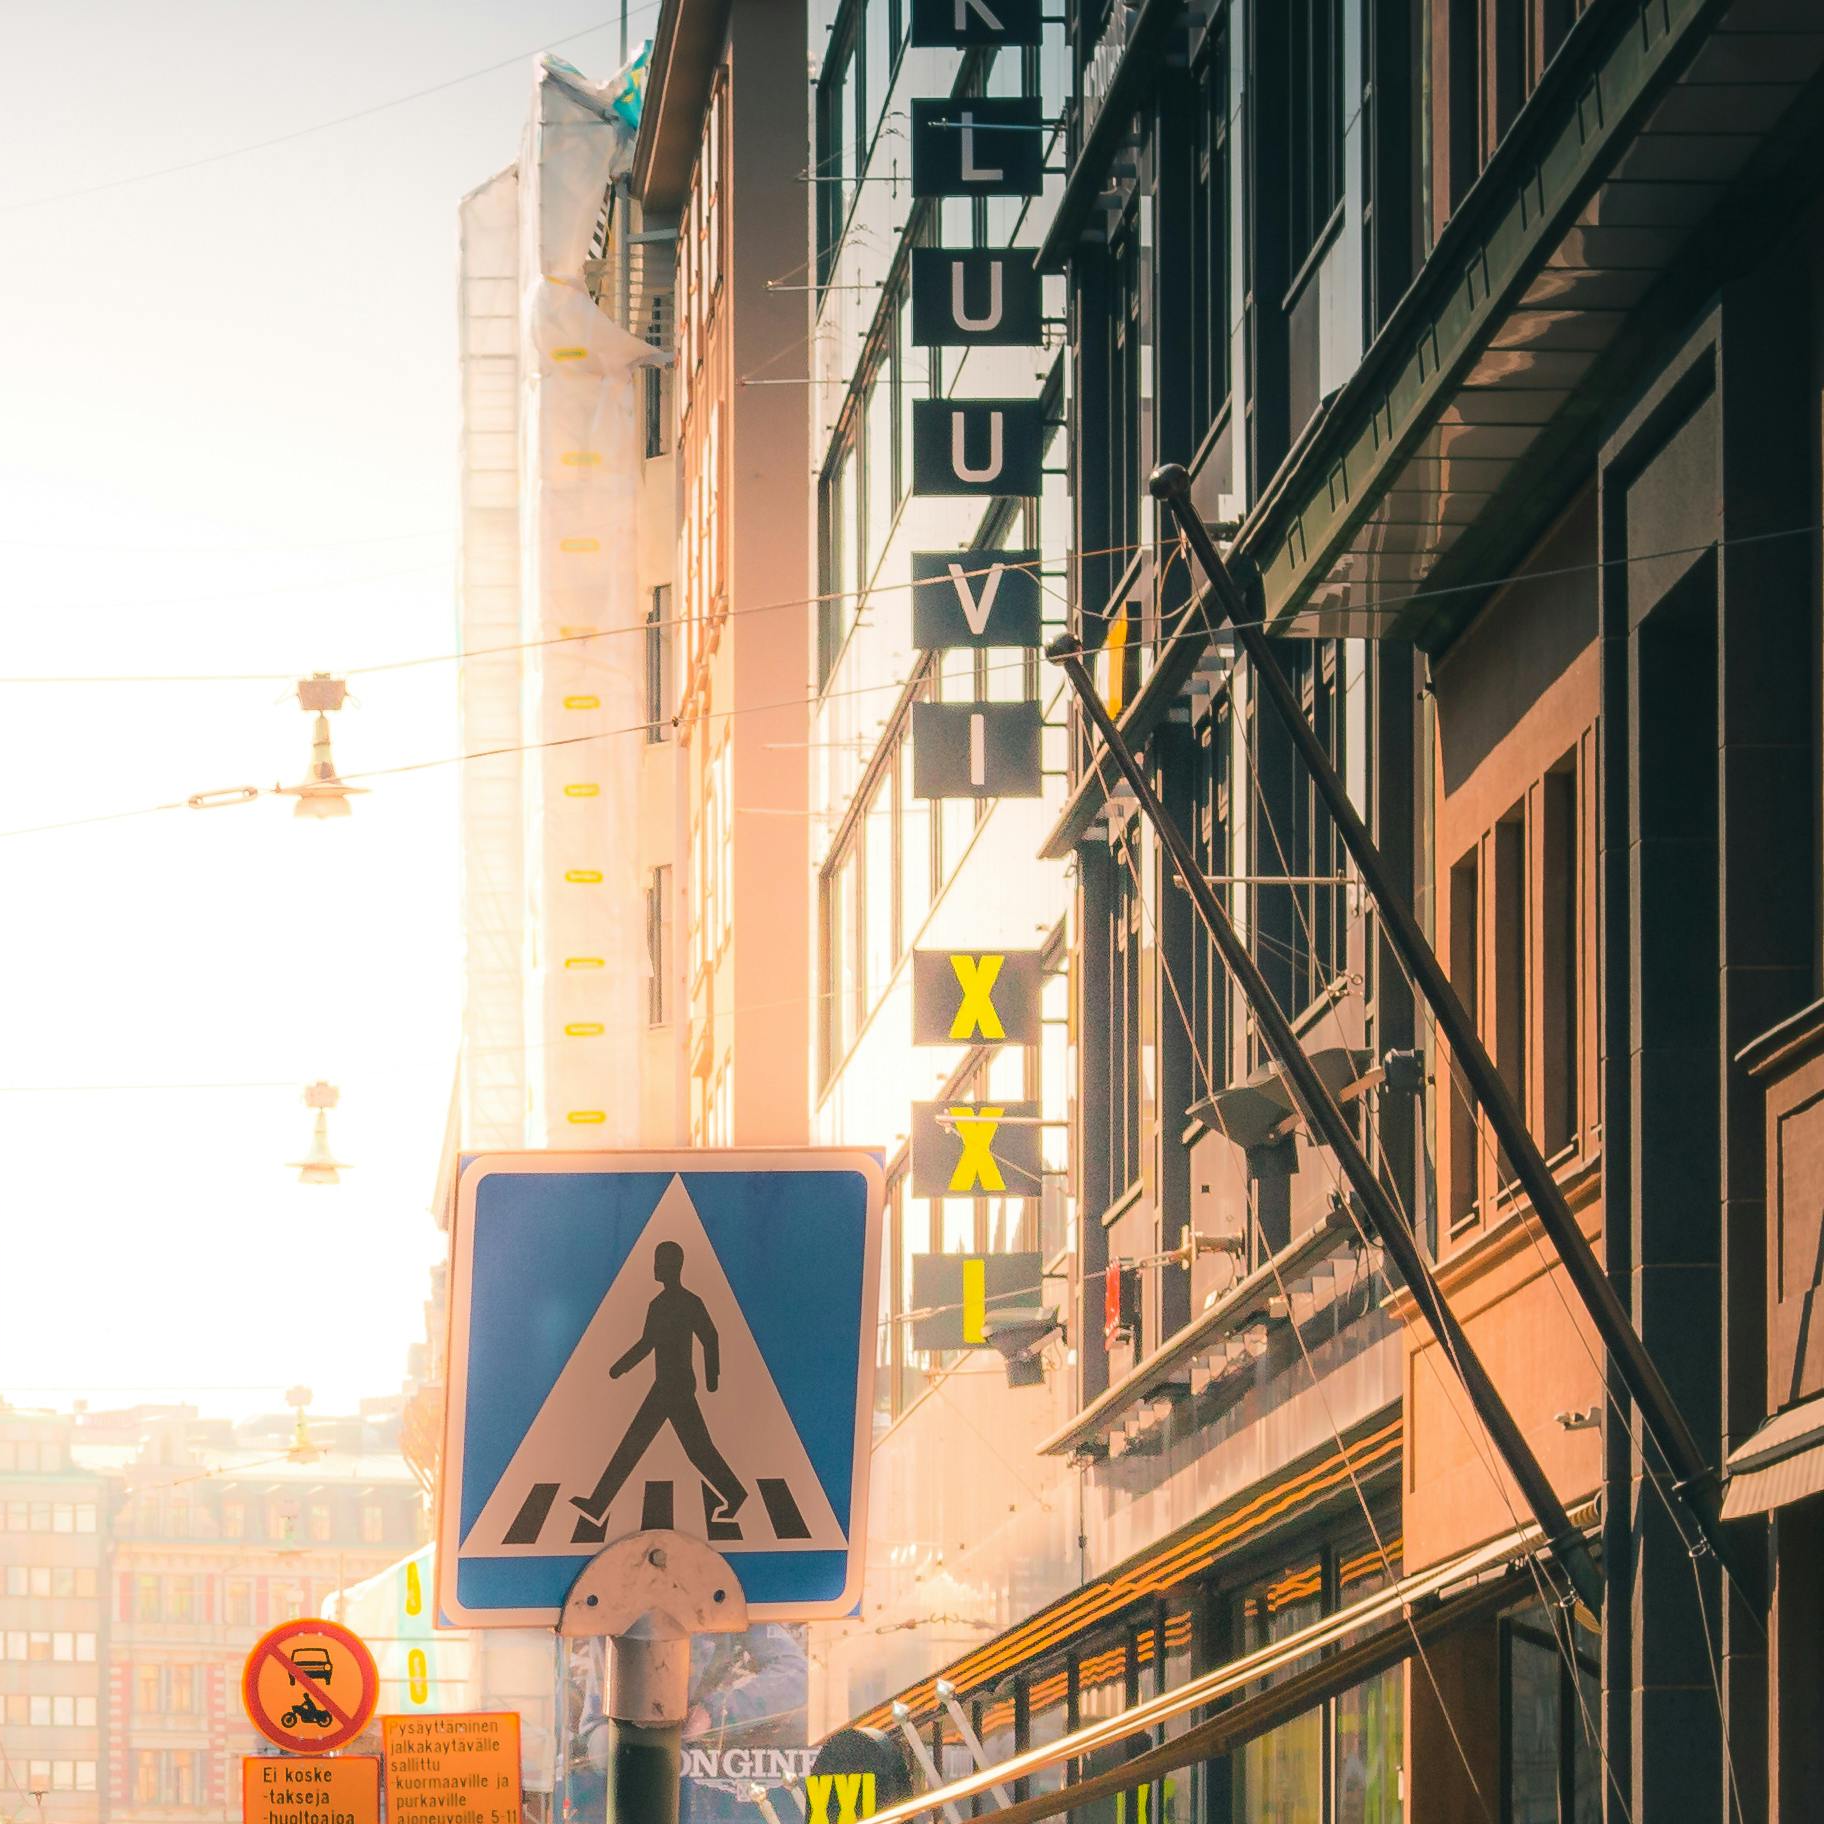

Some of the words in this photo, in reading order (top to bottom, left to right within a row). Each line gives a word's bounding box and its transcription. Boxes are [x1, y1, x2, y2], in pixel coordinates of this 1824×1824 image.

[391, 1758, 440, 1772] sallittu
[263, 1767, 277, 1782] Ei
[285, 1767, 332, 1782] koske
[496, 1773, 509, 1789] ja
[396, 1793, 466, 1810] purkaville
